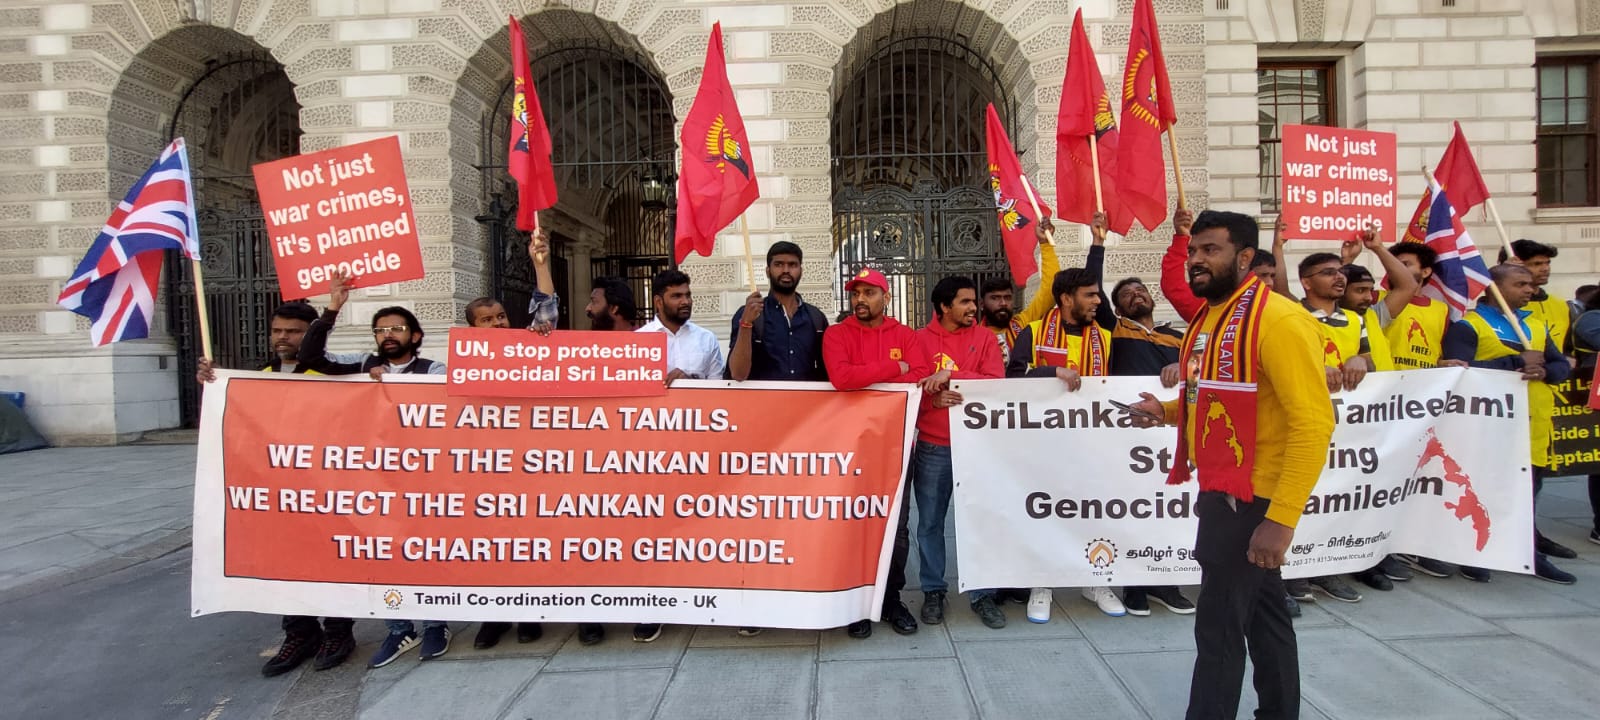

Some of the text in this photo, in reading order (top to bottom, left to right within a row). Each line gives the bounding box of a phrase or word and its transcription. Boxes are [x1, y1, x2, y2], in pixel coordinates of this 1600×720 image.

[1305, 133, 1377, 158] Not just
[282, 152, 375, 191] Not just
[1286, 162, 1393, 185] war crimes,
[268, 186, 405, 226] war crimes,
[1287, 185, 1393, 208] it's planned
[275, 212, 411, 257] it's planned
[1299, 213, 1383, 234] genocide
[297, 250, 402, 290] genocide
[455, 340, 662, 362] UN, stop protecting
[1093, 354, 1102, 376] EELA
[1218, 324, 1238, 379] EELAM
[1394, 356, 1418, 367] TAMIL
[452, 365, 663, 384] genocidal Sri Lanka
[398, 403, 738, 432] WE ARE EELA TAMILS.
[1552, 404, 1593, 417] ause
[268, 443, 863, 476] WE REJECT THE SRI LANKAN IDENTITY.
[1129, 445, 1172, 474] St
[228, 485, 889, 520] WE REJECT THE SRI LANKAN CONSTITUTION
[1302, 476, 1444, 515] amileelm
[333, 534, 795, 565] THE CHARTER FOR GENOCIDE.
[413, 592, 461, 606] Tamil
[466, 592, 586, 607] Co-ordination
[590, 593, 678, 608] Commitee
[693, 594, 718, 609] UK
